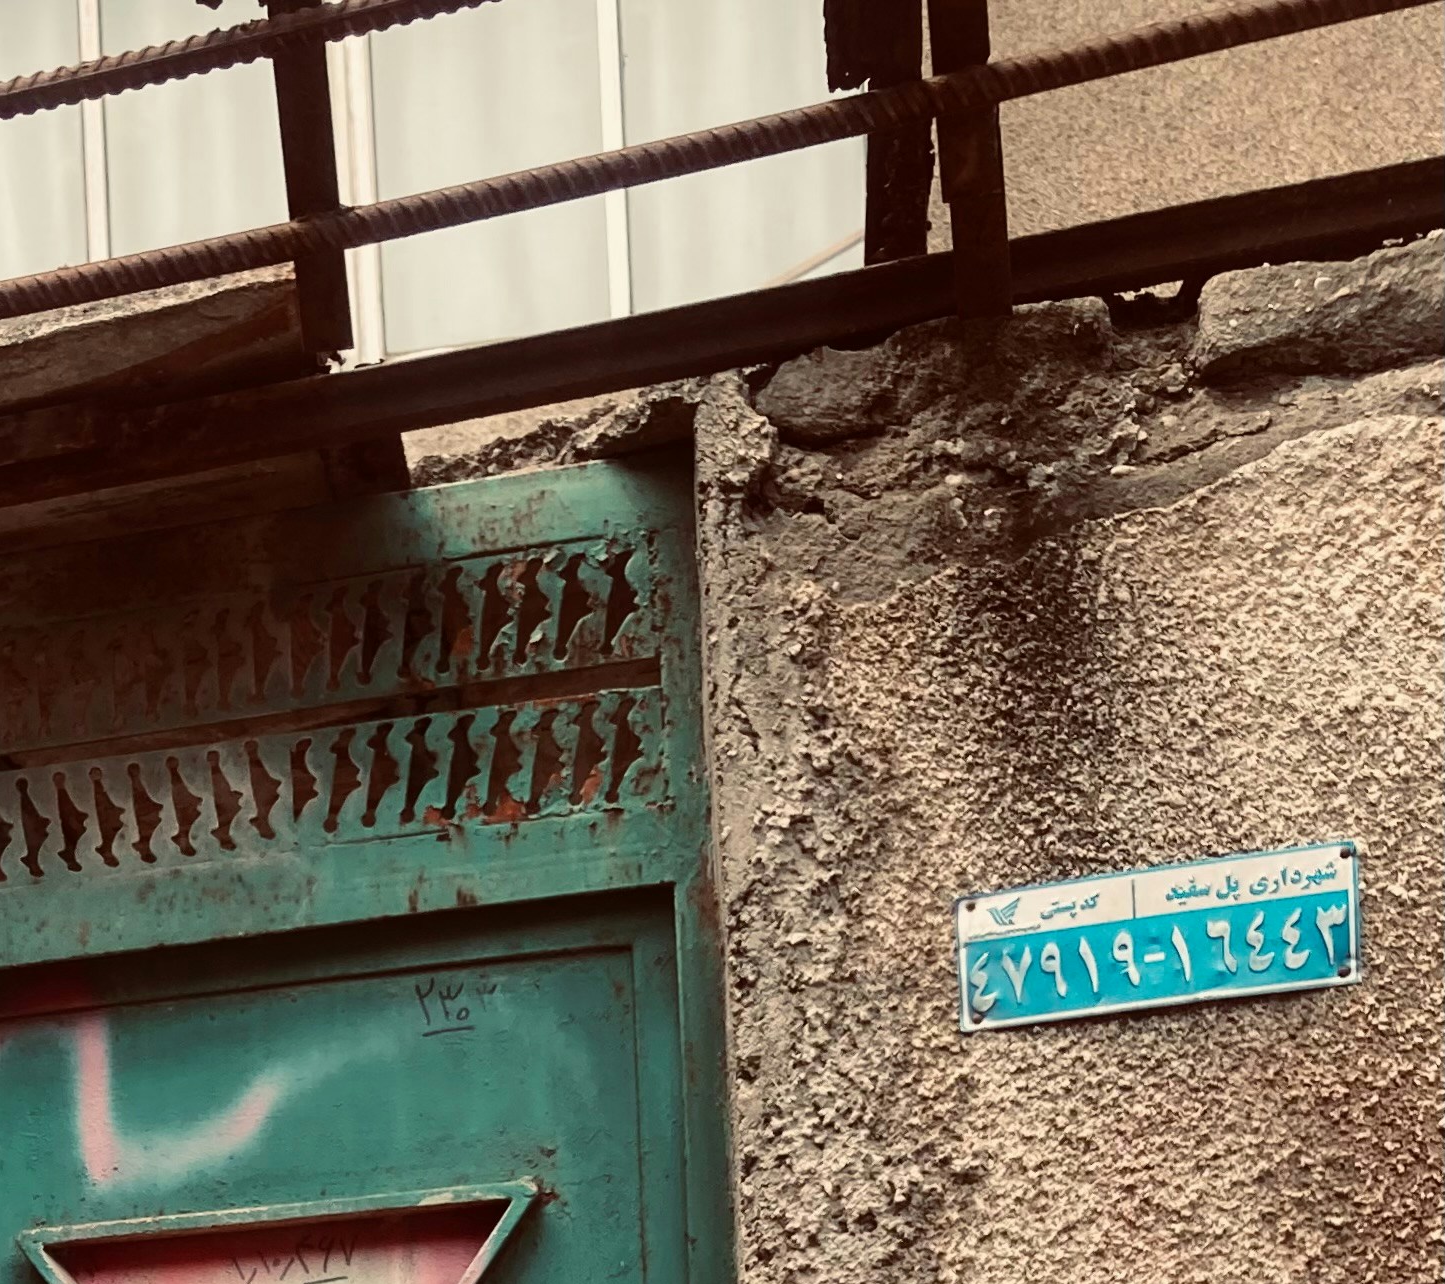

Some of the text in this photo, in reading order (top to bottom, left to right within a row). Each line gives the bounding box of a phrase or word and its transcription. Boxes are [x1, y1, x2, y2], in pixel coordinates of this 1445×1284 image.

[1214, 873, 1243, 904] پل
[1248, 860, 1339, 898] شهرداری
[1039, 891, 1102, 921] کد پستی
